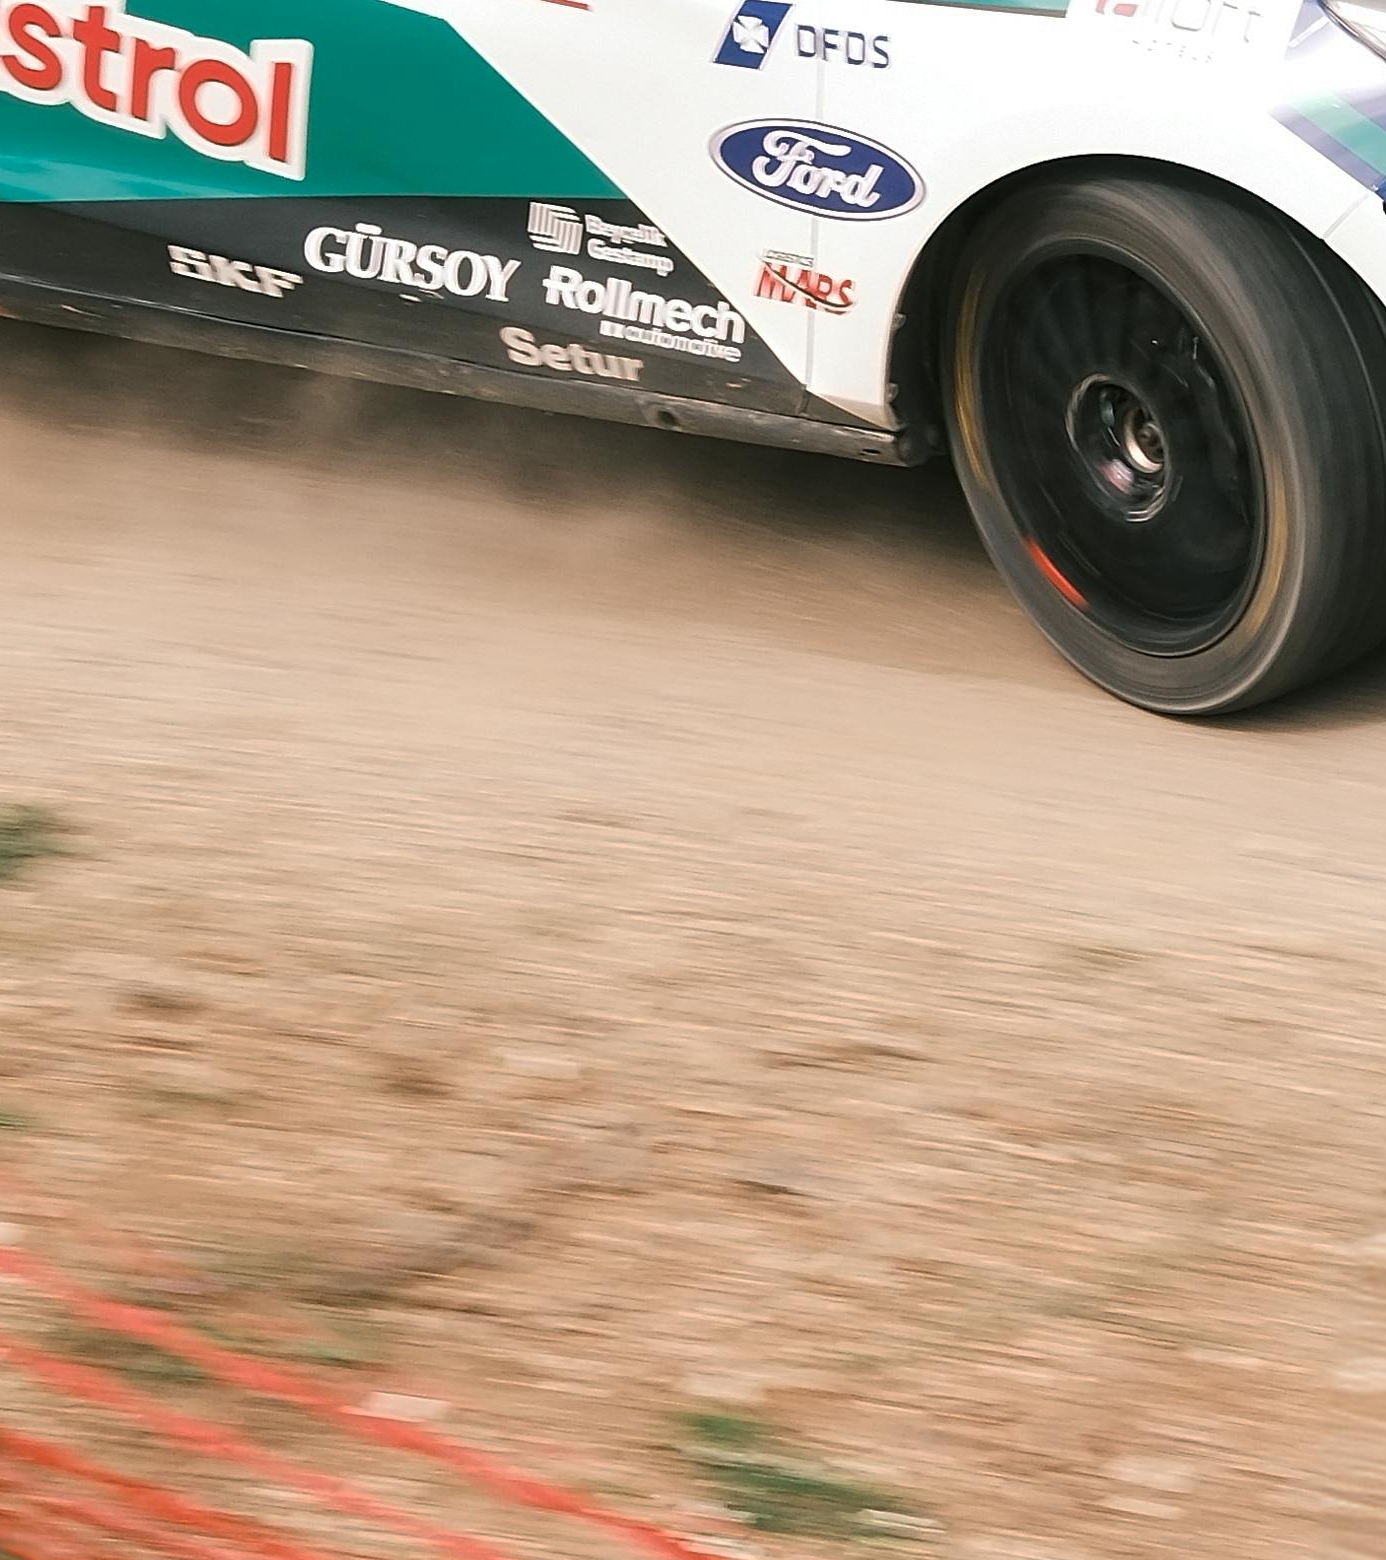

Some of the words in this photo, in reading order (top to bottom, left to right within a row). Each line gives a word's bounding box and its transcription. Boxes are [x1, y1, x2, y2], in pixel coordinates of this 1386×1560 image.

[795, 23, 890, 69] DFDS
[751, 129, 885, 208] Ford
[167, 244, 304, 299] SKF
[303, 222, 522, 303] GÜRSOY
[542, 265, 746, 345] Rollmech
[500, 326, 645, 382] Setur
